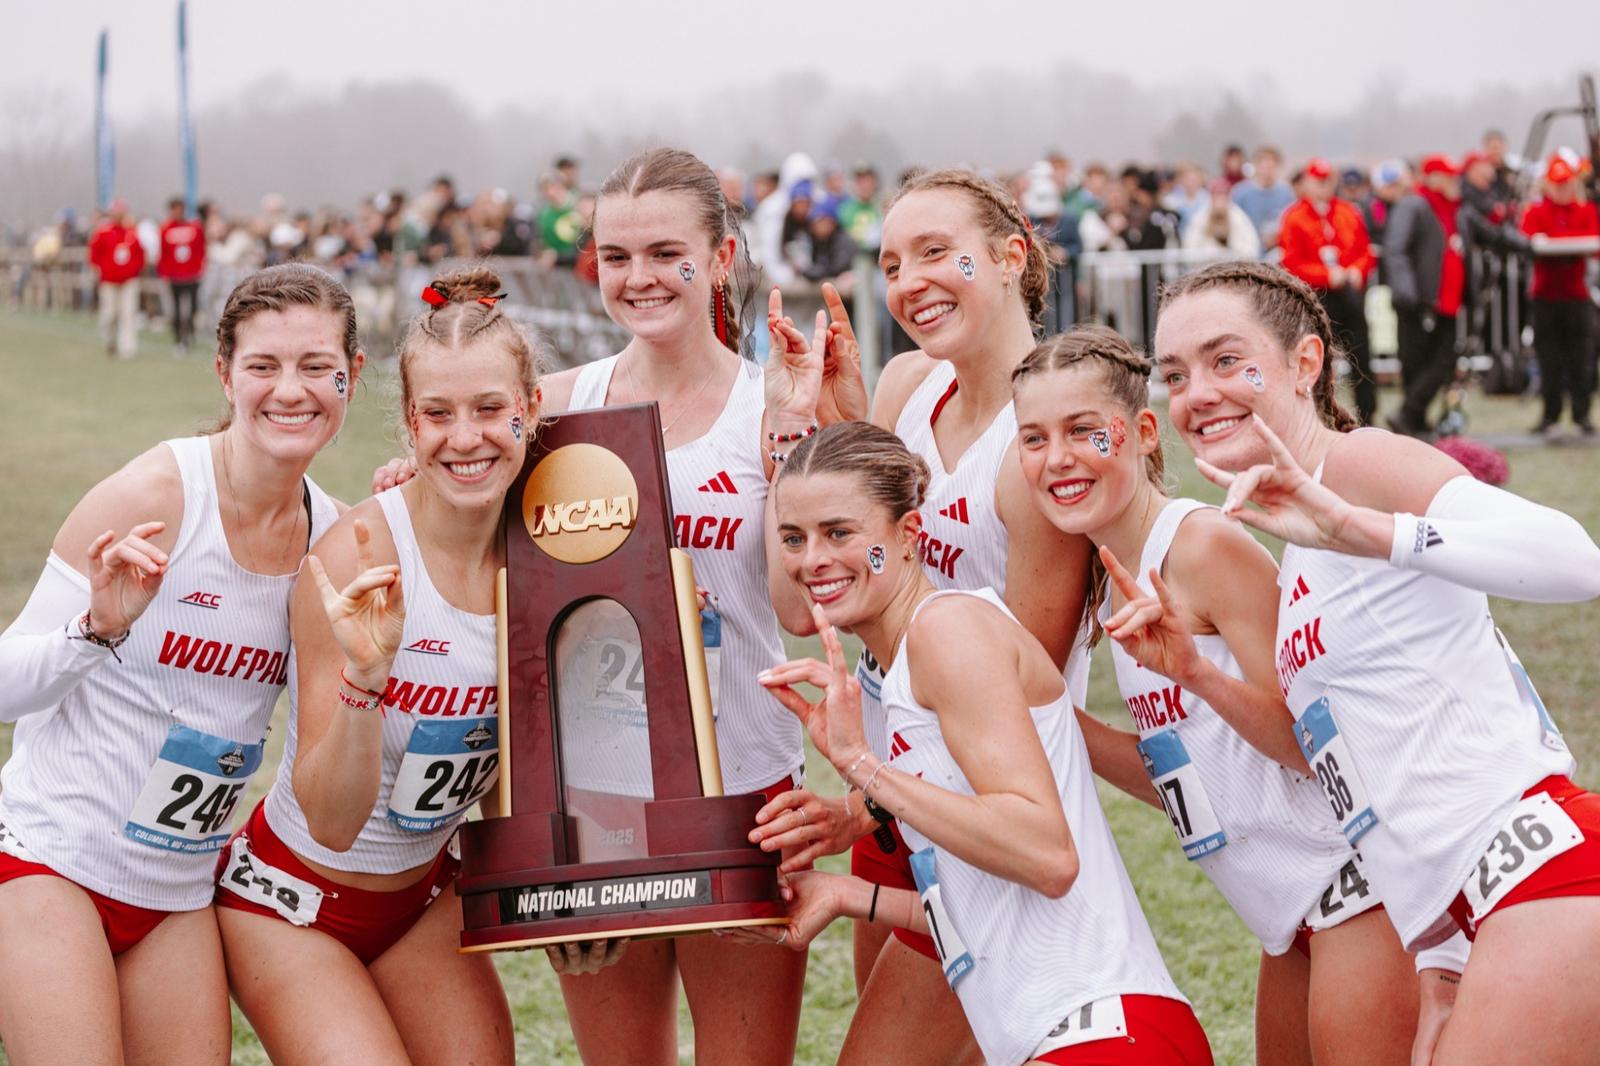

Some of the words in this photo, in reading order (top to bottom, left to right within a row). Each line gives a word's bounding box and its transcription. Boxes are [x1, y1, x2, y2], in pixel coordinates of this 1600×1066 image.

[533, 496, 633, 536] NCAA
[183, 591, 222, 607] ACC
[409, 638, 451, 653] ACC
[414, 752, 499, 811] 242
[156, 773, 246, 834] 245
[1469, 813, 1553, 900] 236
[517, 890, 596, 914] NATIONAL
[601, 877, 697, 906] CHAMPION
